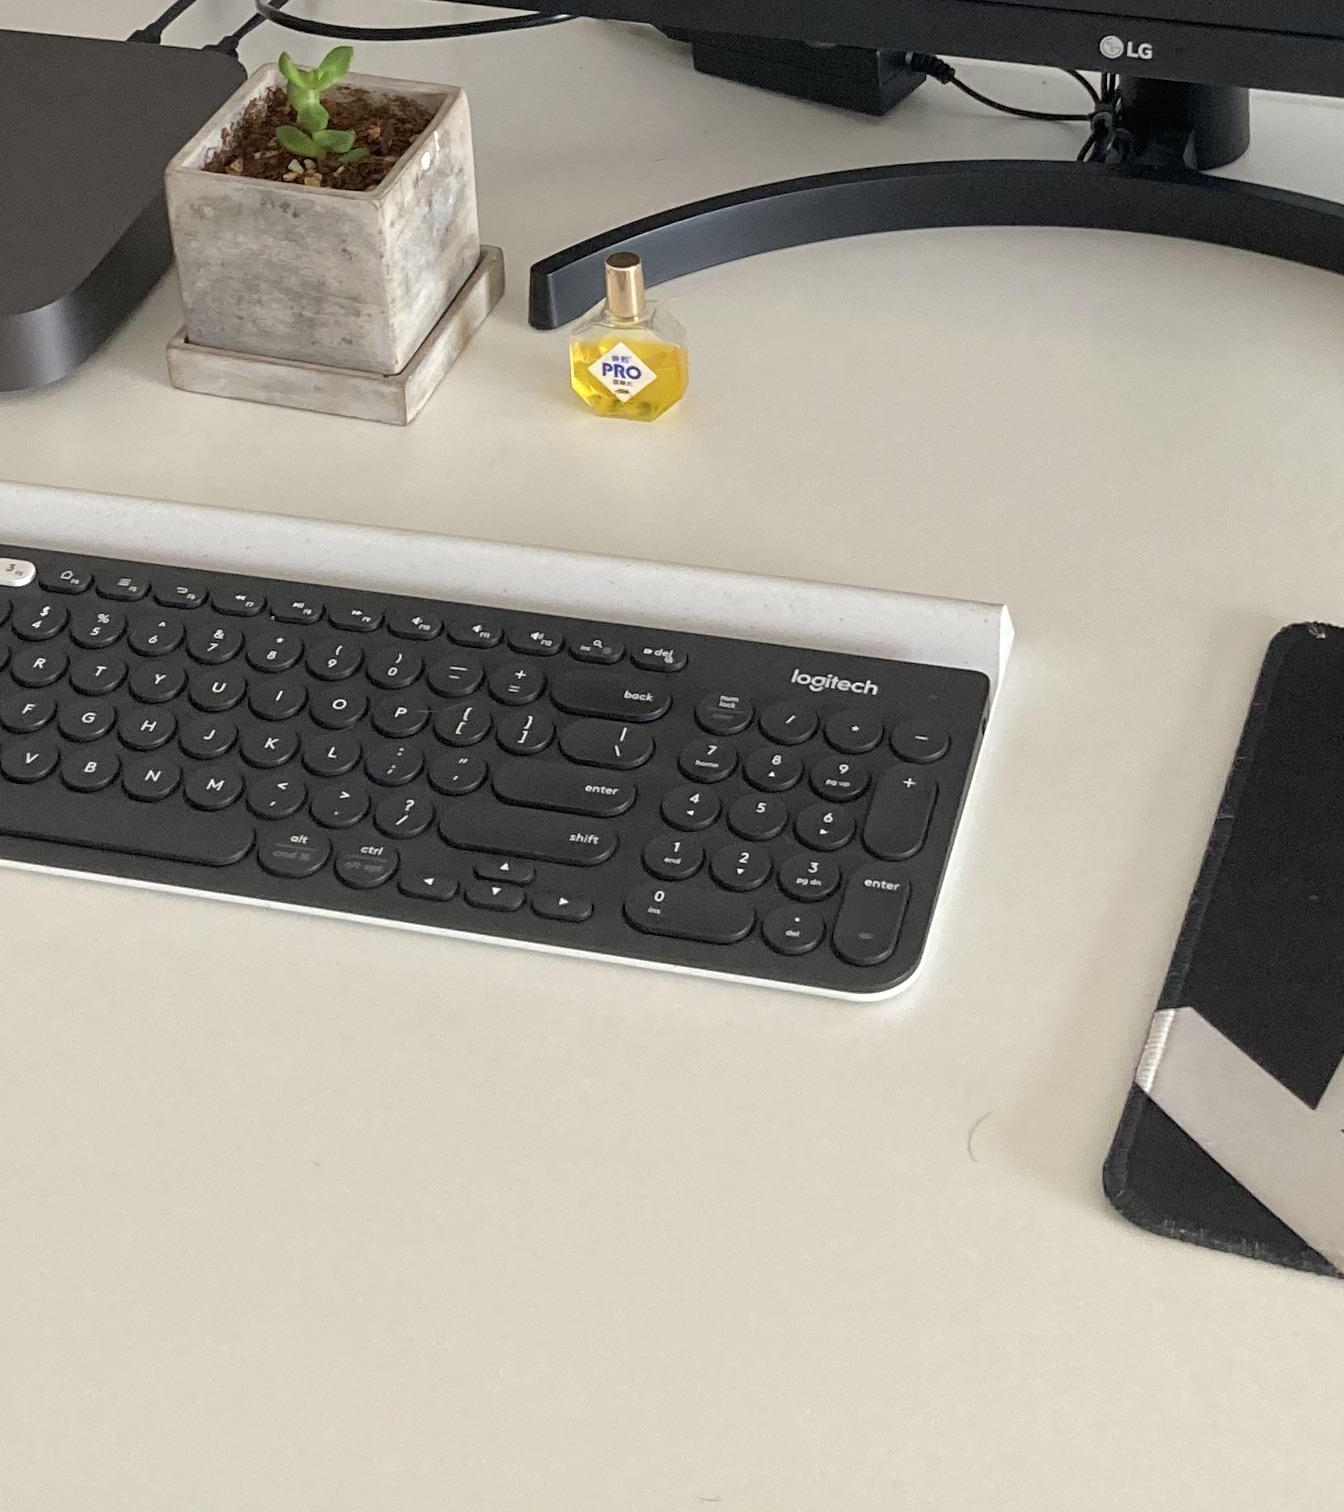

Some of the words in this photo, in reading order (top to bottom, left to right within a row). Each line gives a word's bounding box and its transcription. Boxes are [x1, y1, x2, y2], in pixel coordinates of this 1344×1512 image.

[1126, 41, 1153, 60] LG
[602, 363, 641, 380] PRO
[33, 658, 46, 668] R
[96, 666, 106, 676] T
[155, 674, 166, 684] Y
[791, 669, 878, 695] logitech
[212, 682, 226, 692] U
[624, 690, 653, 701] back
[22, 704, 35, 714] F
[395, 707, 407, 717] P
[82, 713, 96, 723] G
[141, 720, 157, 731] H
[204, 730, 215, 739] J
[265, 738, 279, 749] K
[328, 747, 336, 758] L
[707, 745, 717, 755] 7
[772, 755, 781, 765] 8
[84, 762, 97, 772] B
[839, 764, 849, 774] 9
[145, 770, 161, 781] N
[206, 779, 224, 790] M
[585, 785, 618, 794] enter
[690, 794, 699, 803] 4
[756, 803, 766, 813] 5
[824, 813, 833, 822] 6
[291, 835, 308, 844] alt
[569, 833, 599, 844] shift
[361, 847, 383, 855] ctrl
[739, 853, 749, 863] 2
[808, 862, 818, 873] 3
[865, 880, 900, 890] enter
